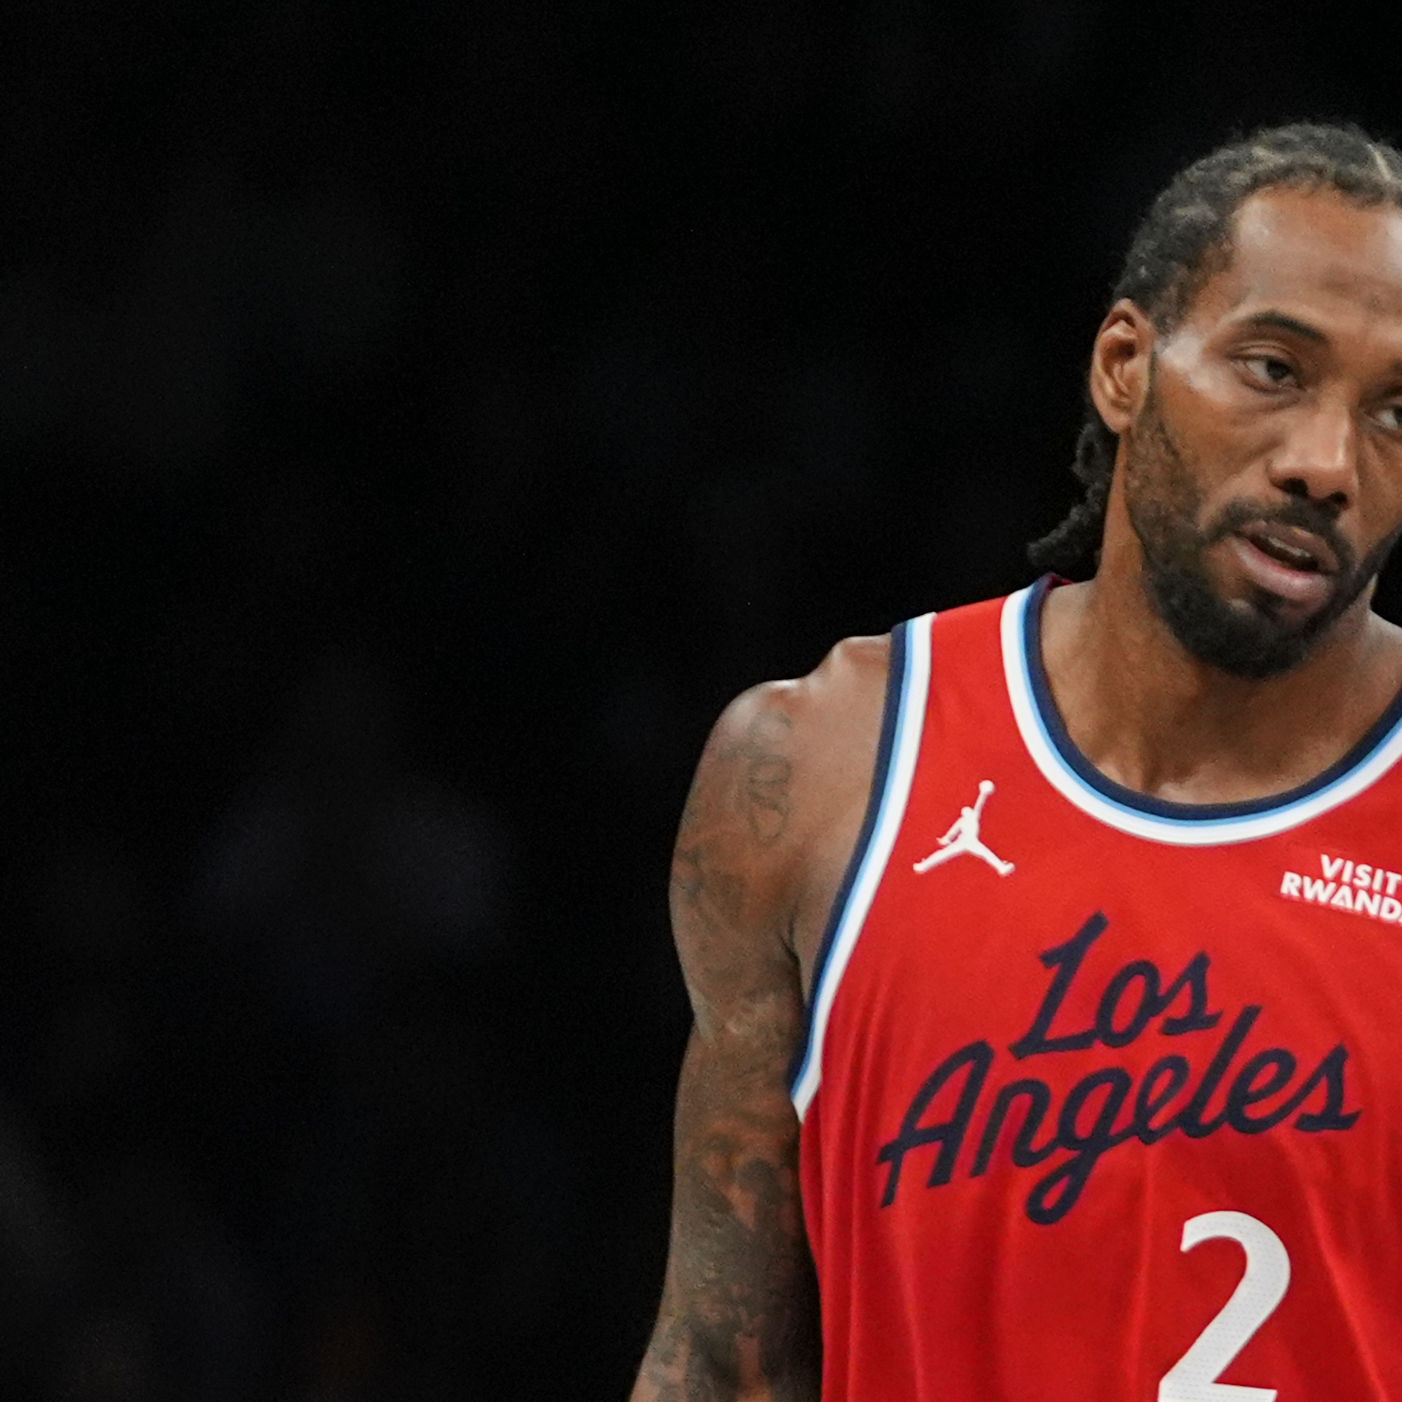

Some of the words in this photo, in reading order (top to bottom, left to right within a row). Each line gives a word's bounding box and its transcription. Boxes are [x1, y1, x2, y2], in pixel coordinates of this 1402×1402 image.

[1320, 854, 1402, 896] VISIT
[1009, 912, 1222, 1061] Los
[877, 1005, 1363, 1226] Angeles
